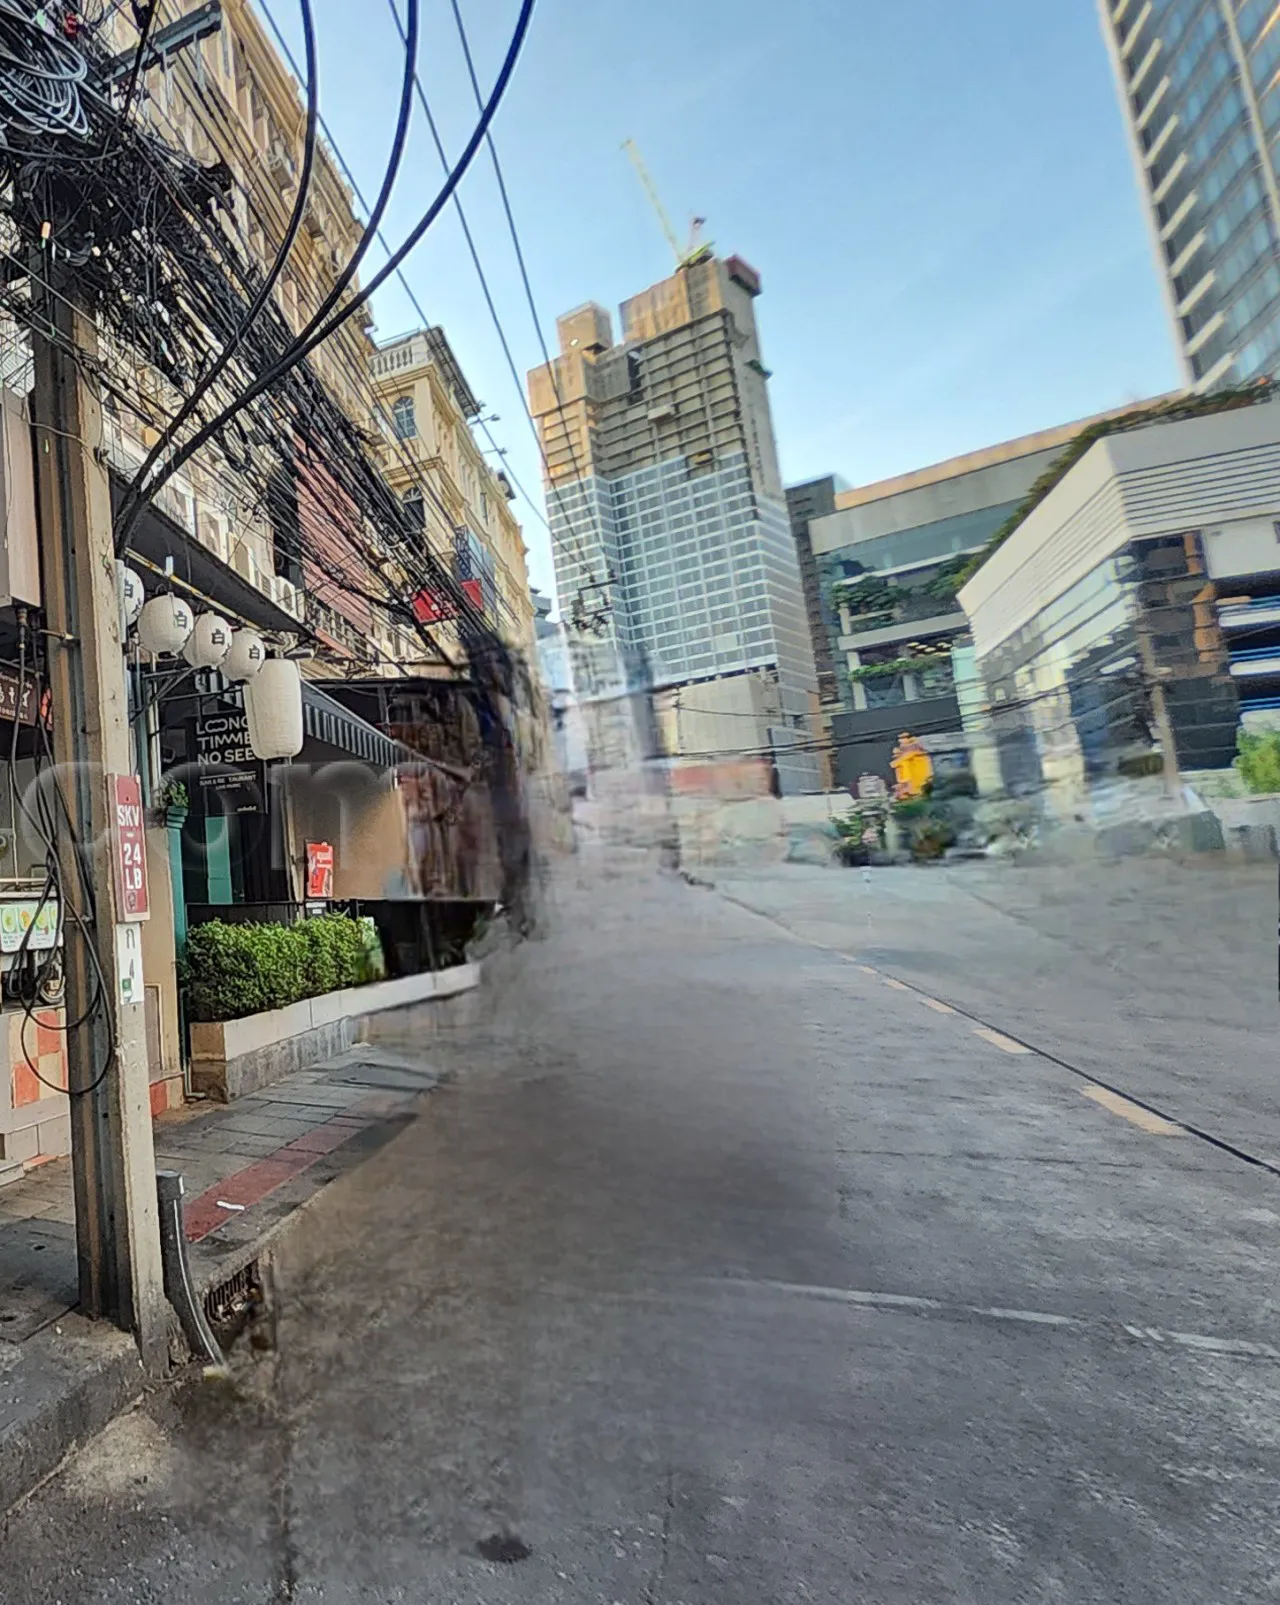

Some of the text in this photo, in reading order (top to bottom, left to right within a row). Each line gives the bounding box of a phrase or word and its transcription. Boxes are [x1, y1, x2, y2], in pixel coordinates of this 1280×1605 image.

[198, 747, 257, 767] NO SEE
[117, 804, 141, 827] SKV
[123, 842, 142, 866] 24
[125, 867, 143, 891] LB
